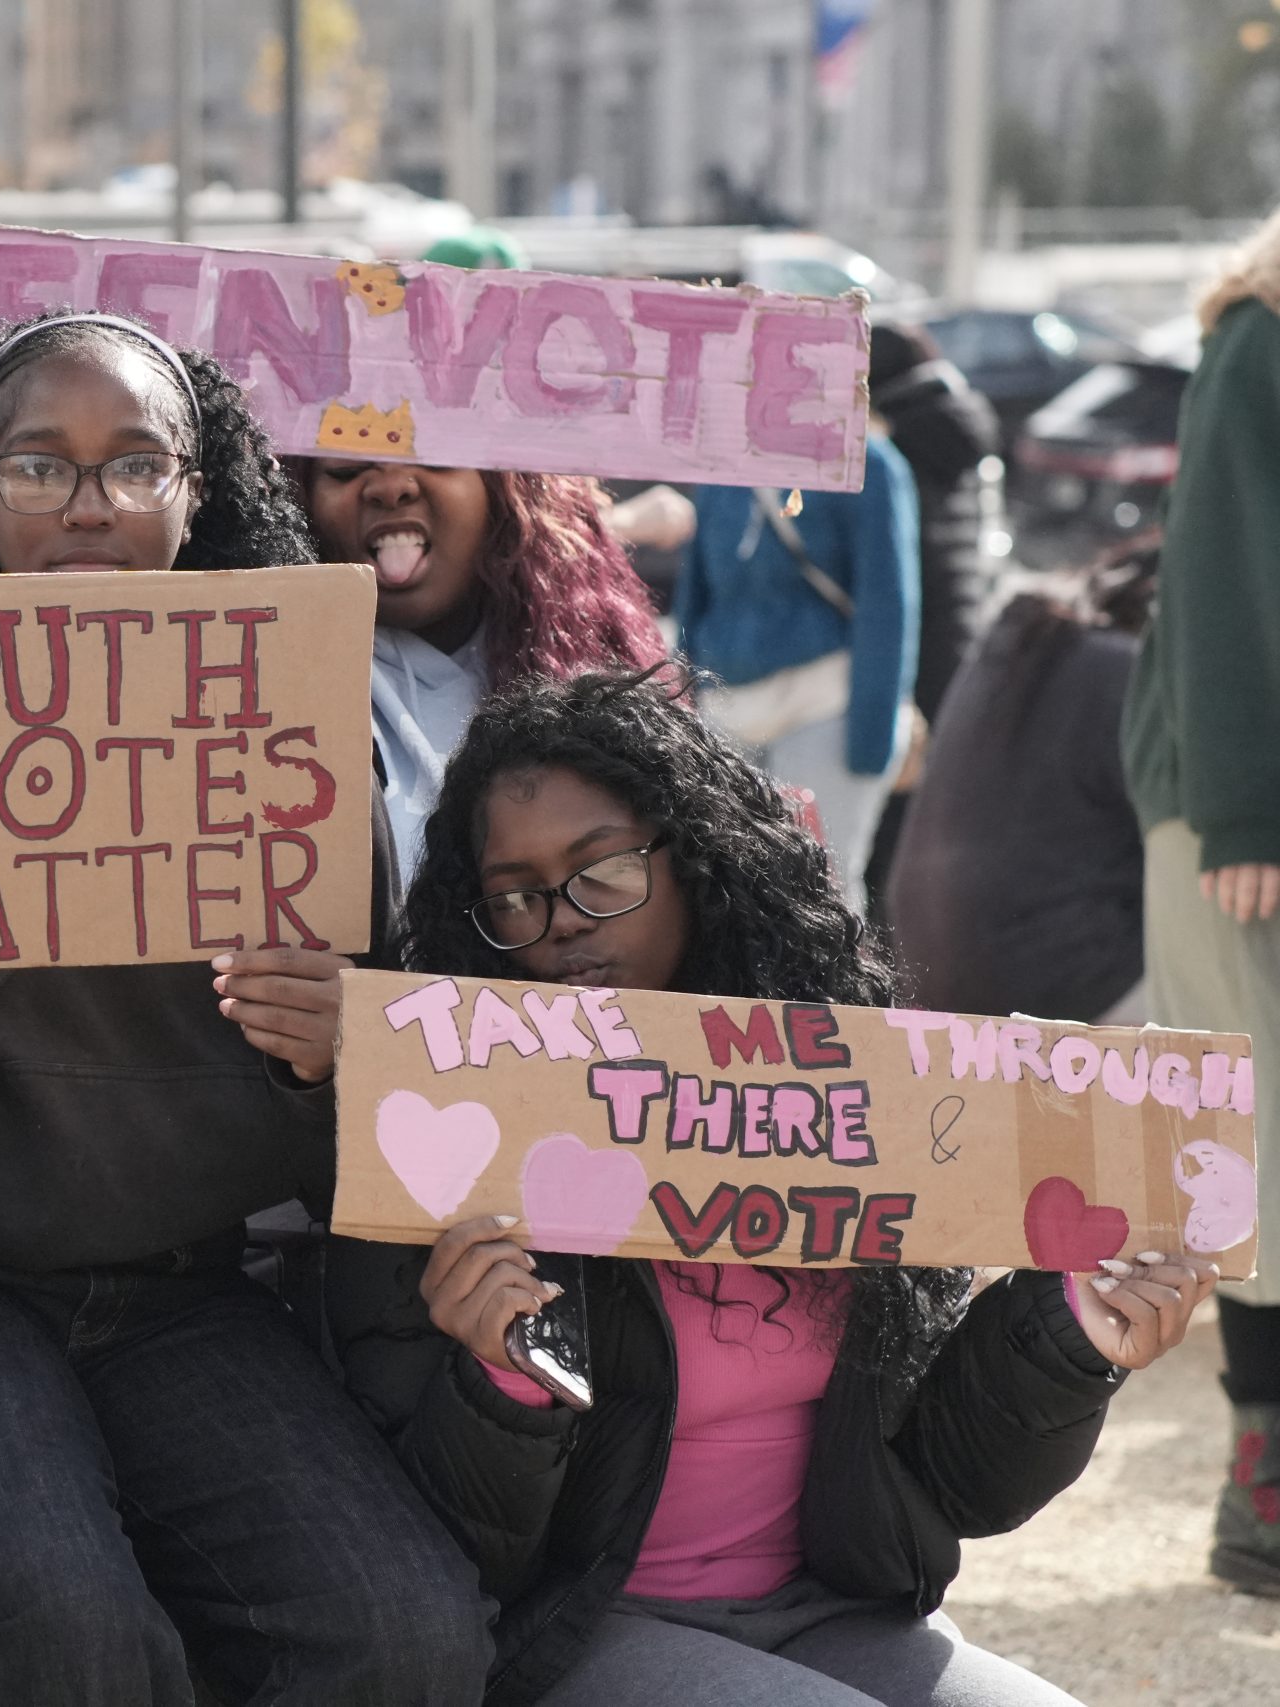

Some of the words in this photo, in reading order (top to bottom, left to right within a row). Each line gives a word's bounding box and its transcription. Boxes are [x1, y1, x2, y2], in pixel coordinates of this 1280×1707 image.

[406, 275, 852, 462] VOTE
[383, 977, 643, 1074] TAKE
[699, 1002, 851, 1070] ME
[885, 1009, 1256, 1120] THROUGH
[587, 1060, 879, 1168] THERE
[931, 1095, 966, 1165] &
[649, 1181, 917, 1264] VOTE
